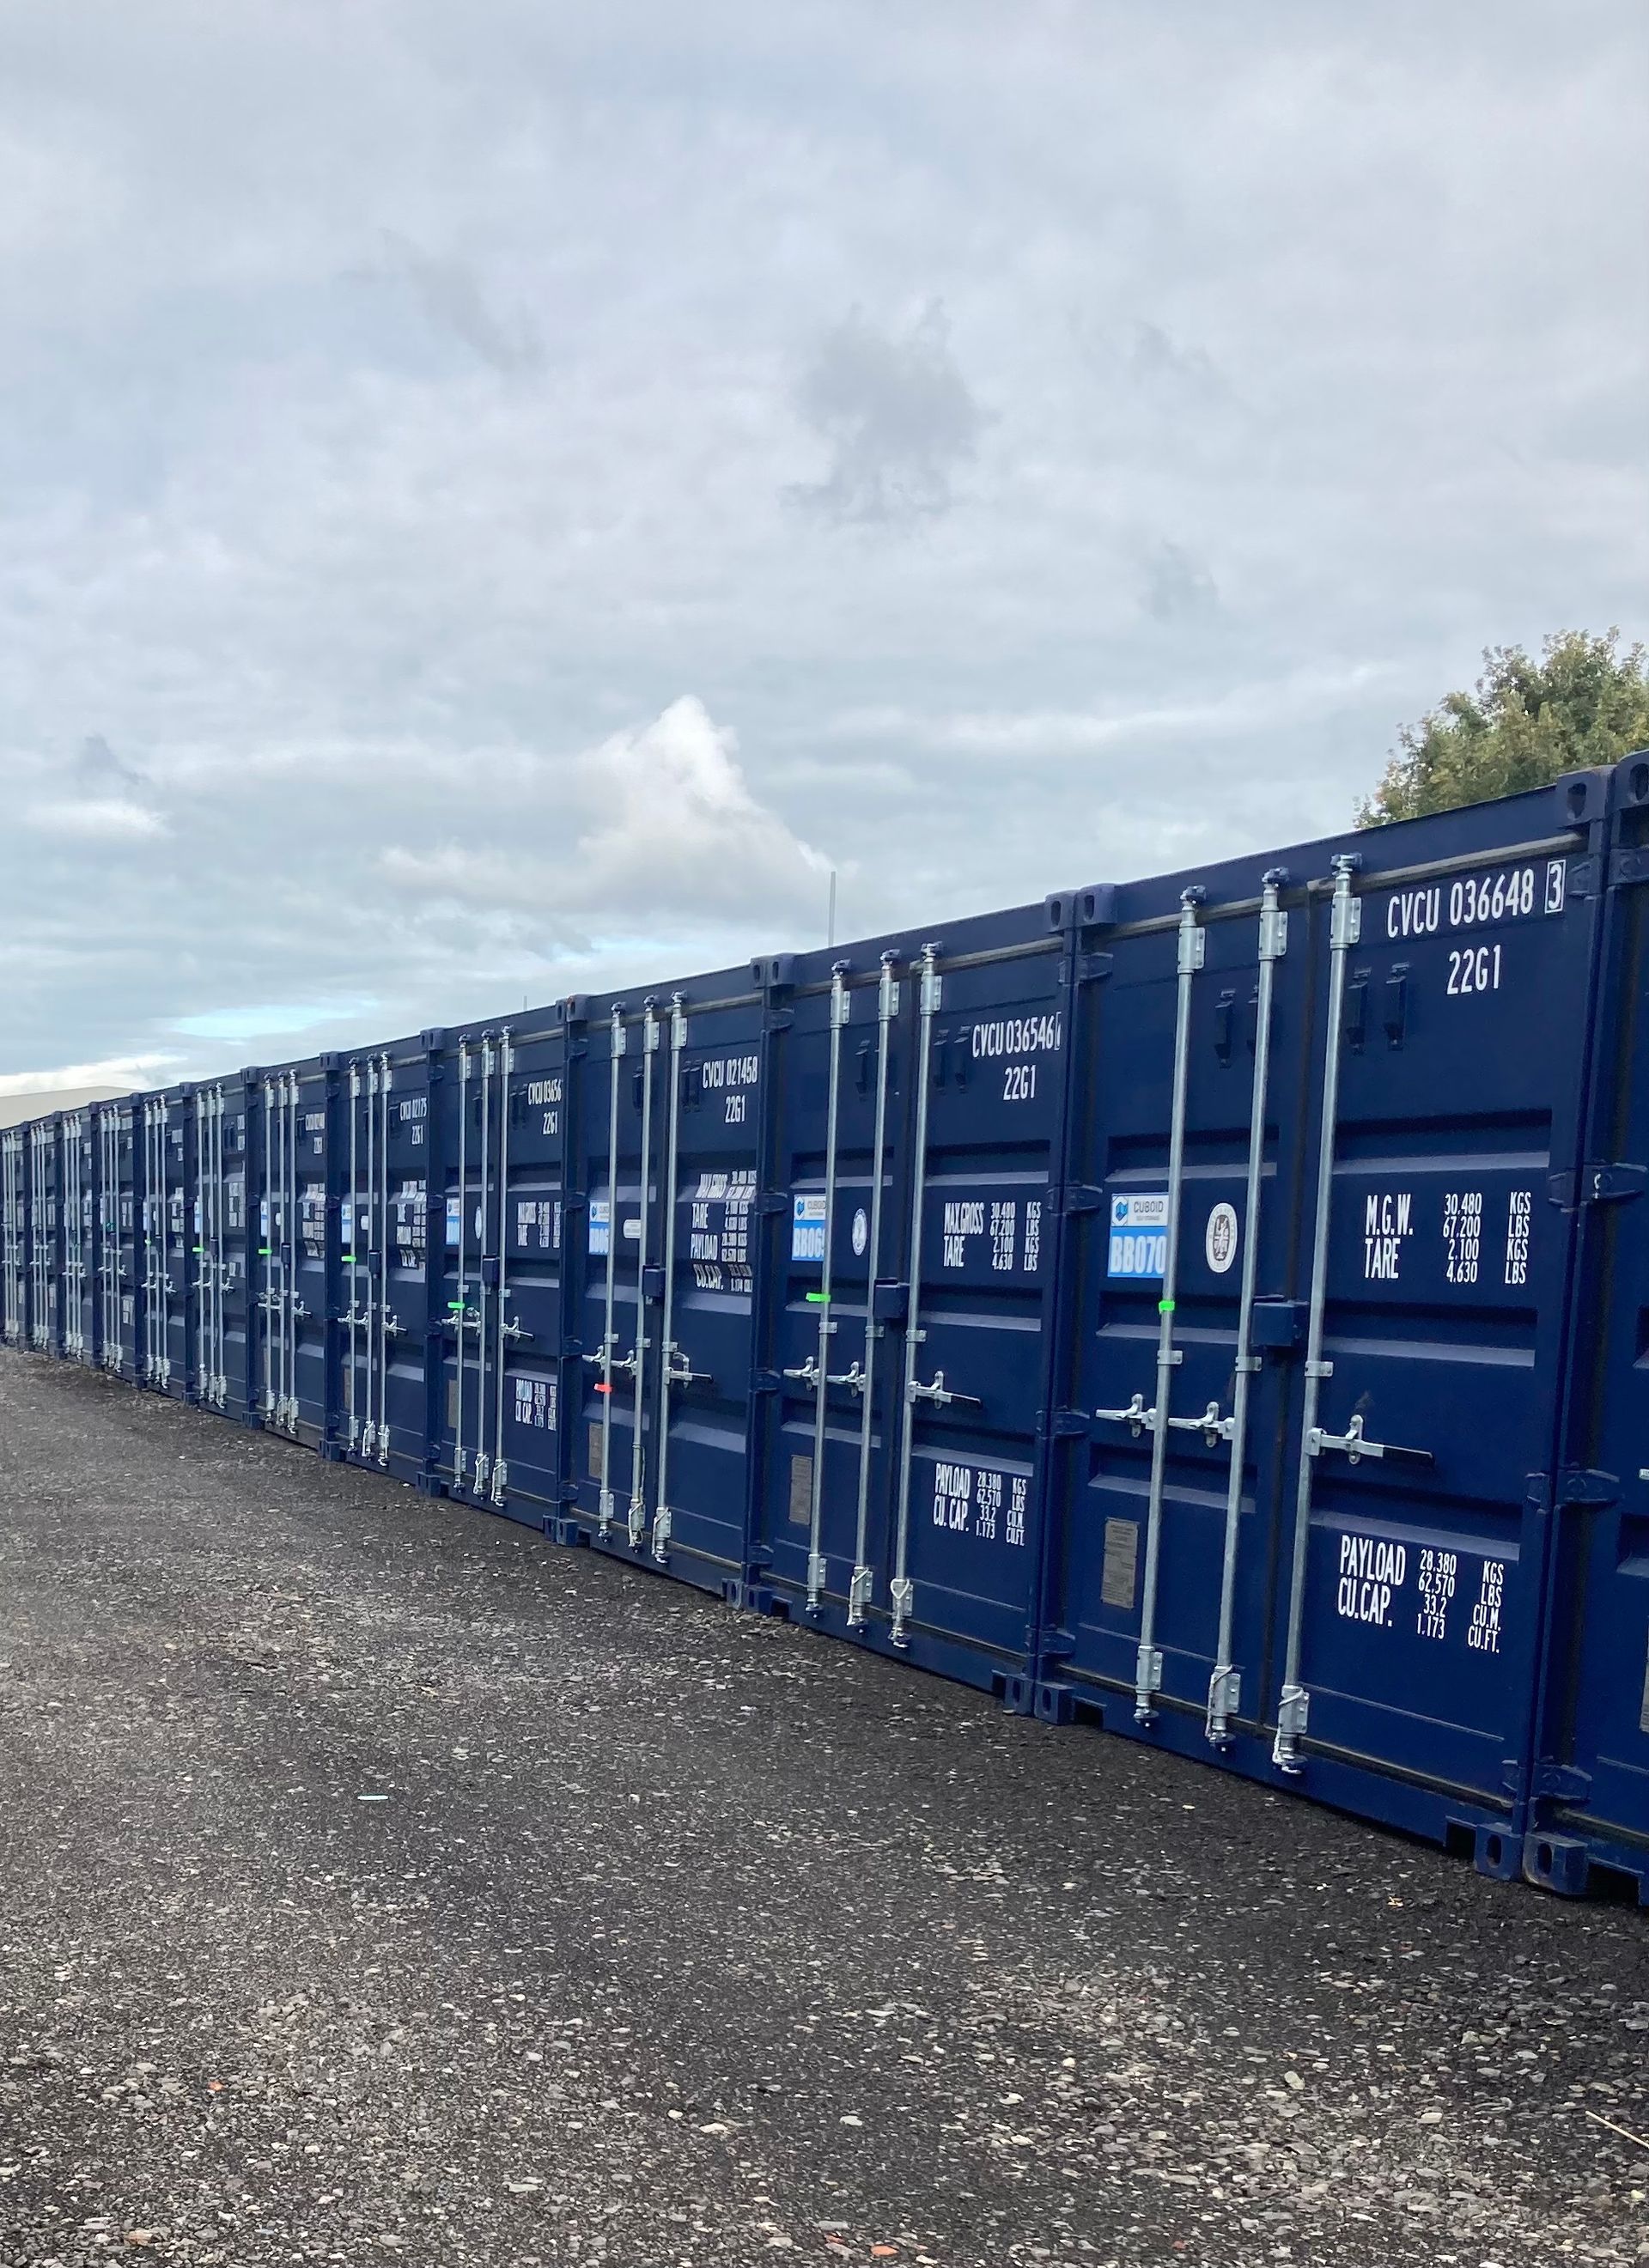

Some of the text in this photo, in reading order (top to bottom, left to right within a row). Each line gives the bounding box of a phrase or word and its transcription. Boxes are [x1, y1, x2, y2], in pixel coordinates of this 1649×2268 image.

[1387, 863, 1562, 938] CVCU 036648 3
[1447, 945, 1501, 995] 22G1
[973, 1022, 1004, 1057] CVCU
[703, 1060, 725, 1089] CVCU
[1003, 1065, 1036, 1100] 22G1
[725, 1095, 745, 1122] 22G1
[1026, 1201, 1041, 1219] KGS
[1134, 1201, 1164, 1213] CUBOID
[1366, 1194, 1414, 1235] M.G.W.
[1510, 1192, 1530, 1214] KGS
[1508, 1215, 1530, 1237] LBS
[691, 1233, 718, 1260] PAYLOAD
[944, 1236, 965, 1267] TARE
[1025, 1237, 1039, 1253] KGS
[1110, 1235, 1168, 1274] BB070
[1364, 1237, 1401, 1279] TARE
[1506, 1239, 1528, 1261] KGS
[1024, 1254, 1037, 1271] LBS
[1505, 1262, 1526, 1284] LBS
[935, 1462, 971, 1499] PAYLOAD
[1340, 1535, 1406, 1585] PAYLOAD
[1482, 1560, 1504, 1585] KGS
[1338, 1577, 1393, 1627] CU.CAP.
[1423, 1593, 1447, 1618] 33.2
[1481, 1583, 1502, 1607] LBS
